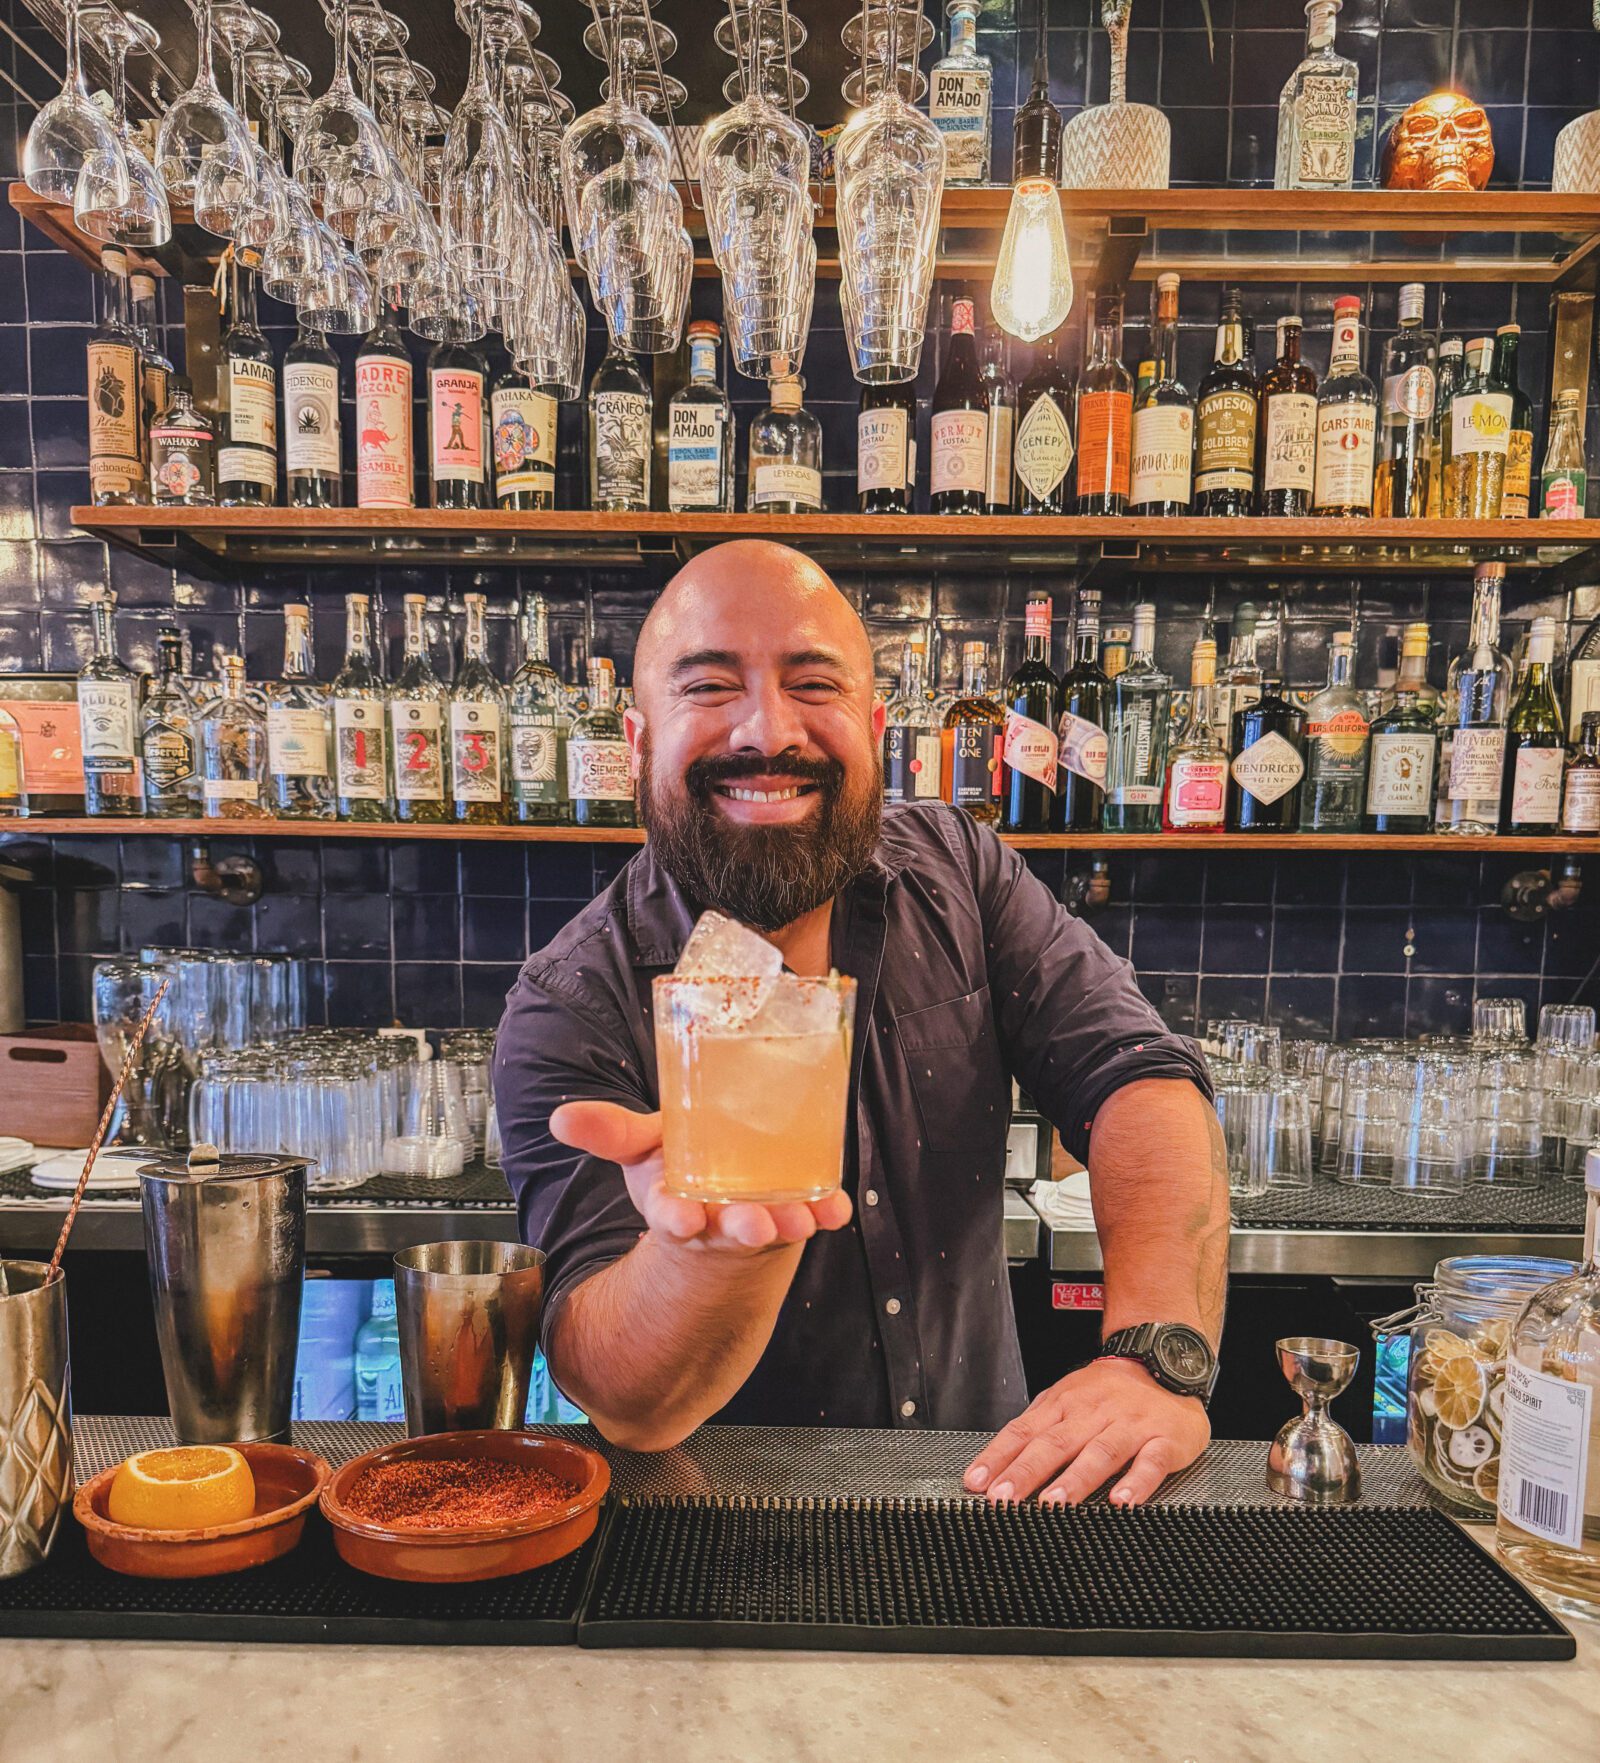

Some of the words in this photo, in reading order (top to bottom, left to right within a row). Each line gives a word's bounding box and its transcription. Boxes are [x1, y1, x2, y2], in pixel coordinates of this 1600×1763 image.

[938, 77, 964, 91] DON
[936, 92, 981, 107] AMADO
[1318, 92, 1337, 102] DON
[1304, 103, 1350, 120] AMADO
[286, 376, 334, 389] FIDENCIO
[436, 379, 480, 391] GRANJA
[600, 394, 641, 403] MEZCAL
[598, 400, 645, 417] CRÁNEO
[1198, 396, 1255, 420] JAMESON
[674, 409, 697, 424] DON
[672, 423, 715, 438] AMADO
[1321, 418, 1374, 433] CARSTAIRS
[158, 437, 200, 448] WAHAKA
[1202, 437, 1223, 450] COLD
[1225, 436, 1249, 448] BREW
[511, 714, 553, 726] UCHADOR
[959, 727, 982, 738] TEN
[1312, 724, 1326, 733] LAS
[354, 730, 367, 768] 1
[959, 737, 977, 748] TO
[1135, 719, 1152, 777] AMSTERDAM
[406, 732, 431, 769] 2
[463, 734, 489, 771] 3
[959, 748, 982, 758] ONE
[1382, 744, 1425, 762] CONDESA
[589, 763, 628, 777] SIEMPRE
[1236, 763, 1301, 775] HENDRICK'S
[521, 782, 545, 790] TEQUILA
[1391, 783, 1410, 791] GIN
[1083, 1286, 1103, 1298] L&
[1522, 1392, 1543, 1410] SPIRIT
